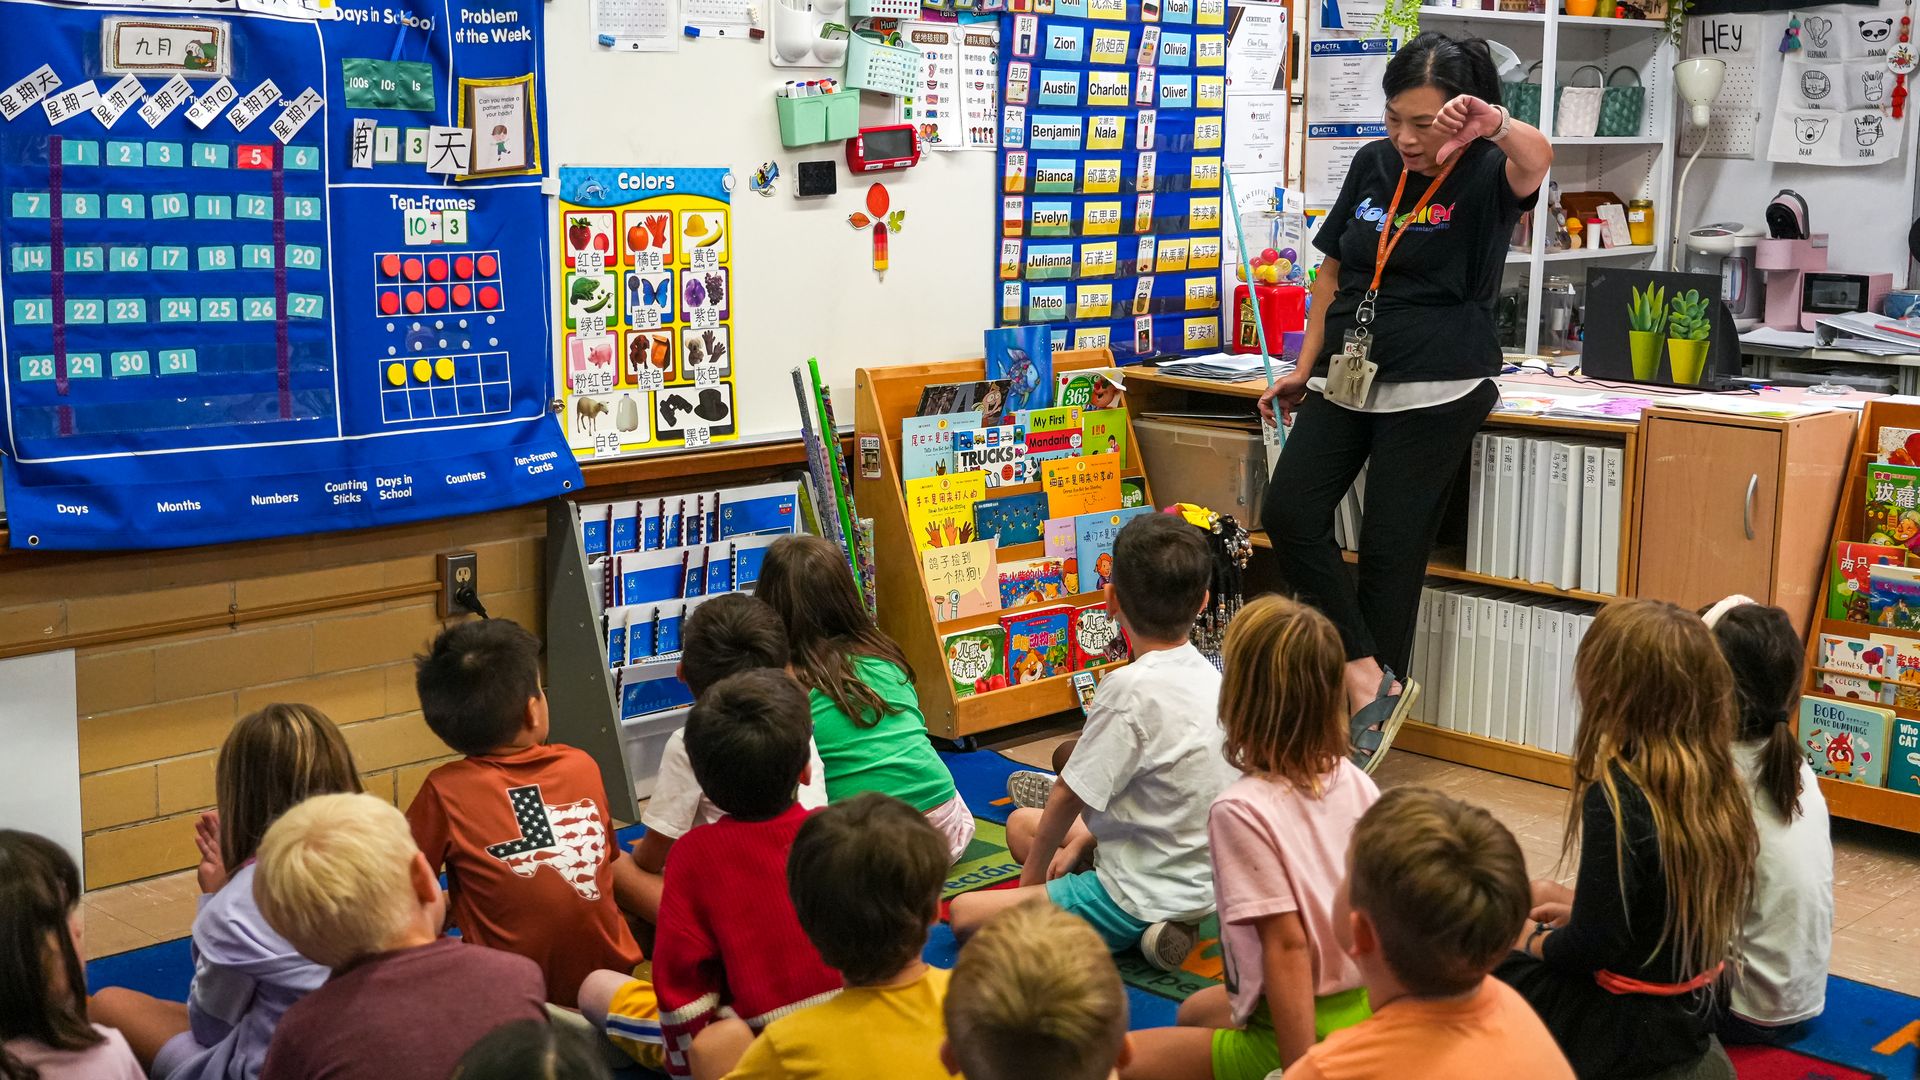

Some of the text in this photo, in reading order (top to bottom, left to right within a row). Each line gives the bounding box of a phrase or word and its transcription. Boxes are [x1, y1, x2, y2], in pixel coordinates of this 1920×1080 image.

[1168, 0, 1188, 12] Noah
[334, 7, 368, 26] Days
[371, 8, 379, 22] in
[461, 8, 518, 24] Problem
[455, 26, 532, 43] of the Week
[1702, 20, 1742, 54] HEY
[136, 37, 172, 56] 九月
[1054, 37, 1076, 50] Zion
[1164, 43, 1187, 55] Olivia
[1010, 67, 1028, 79] 月历
[350, 77, 421, 91] 100s 10s 1s
[1043, 81, 1076, 95] Austin
[1089, 83, 1127, 96] Charlott
[0, 71, 58, 116] 星期天
[1162, 86, 1187, 98] Oliver
[47, 91, 95, 121] 星期一
[97, 80, 141, 125] 星期二
[143, 79, 188, 126] 星期三
[231, 84, 278, 128] 星期五
[274, 93, 321, 139] 星期六
[1007, 110, 1023, 121] 天气
[1032, 125, 1080, 140] Benjamin
[1094, 127, 1116, 138] Nala
[354, 122, 372, 163] 第
[384, 136, 422, 154] 1 3
[78, 144, 306, 165] 1 2 3 4 5 6
[430, 132, 467, 169] 天
[1799, 148, 1812, 156] BEAR
[1009, 155, 1025, 166] 铅笔
[618, 172, 675, 192] Colors
[1037, 170, 1073, 182] Bianca
[28, 197, 312, 216] 7 8 9 10 11 12 13
[390, 194, 476, 211] Ten-Frames
[1034, 211, 1068, 225] Evelyn
[1088, 210, 1118, 224] 伍思思
[409, 217, 459, 236] 10 3
[1004, 244, 1019, 255] 剪刀
[1140, 239, 1153, 249] 扫地
[24, 248, 314, 267] 14 15 16 17 18 19 20
[578, 252, 602, 267] 红色
[637, 252, 660, 266] 橘色
[694, 248, 716, 263] 黄色
[1085, 251, 1113, 265] 石诺兰
[1193, 245, 1217, 259] 金巧艺
[1028, 255, 1072, 267] Julianna
[1005, 285, 1020, 295] 发纸
[1189, 286, 1214, 299] 柯百迪
[26, 298, 316, 320] 21 22 23 24 25 26 27
[1032, 296, 1062, 308] Mateo
[635, 308, 658, 324] 蓝色
[695, 308, 717, 322] 紫色
[580, 316, 605, 332] 绿色
[1188, 325, 1215, 340] 罗安利
[29, 353, 186, 376] 28 29 30 31
[575, 372, 612, 388] 粉红色
[639, 370, 663, 385] 棕色
[696, 366, 719, 381] 灰色
[1066, 388, 1090, 405] 365
[1033, 414, 1065, 428] My First
[596, 432, 620, 448] 白色
[686, 427, 710, 442] 黑色
[1030, 436, 1070, 448] Mandarin
[514, 450, 558, 467] Ten-Frame
[961, 446, 1014, 467] TRUCKS
[527, 462, 554, 475] Cards
[376, 474, 412, 490] Days in
[446, 470, 486, 485] Counters
[325, 479, 368, 493] Counting
[379, 487, 412, 500] School
[251, 493, 299, 506] Numbers
[333, 492, 362, 505] Sticks
[1875, 482, 1920, 508] 拔蘿
[57, 503, 89, 516] Days
[157, 499, 201, 513] Months
[929, 551, 971, 570] 鸽子捡到
[958, 643, 980, 659] 儿歌
[1836, 660, 1863, 671] CHINESE
[1814, 703, 1845, 721] BOBO
[1900, 724, 1918, 735] Who
[1899, 734, 1918, 748] CAT
